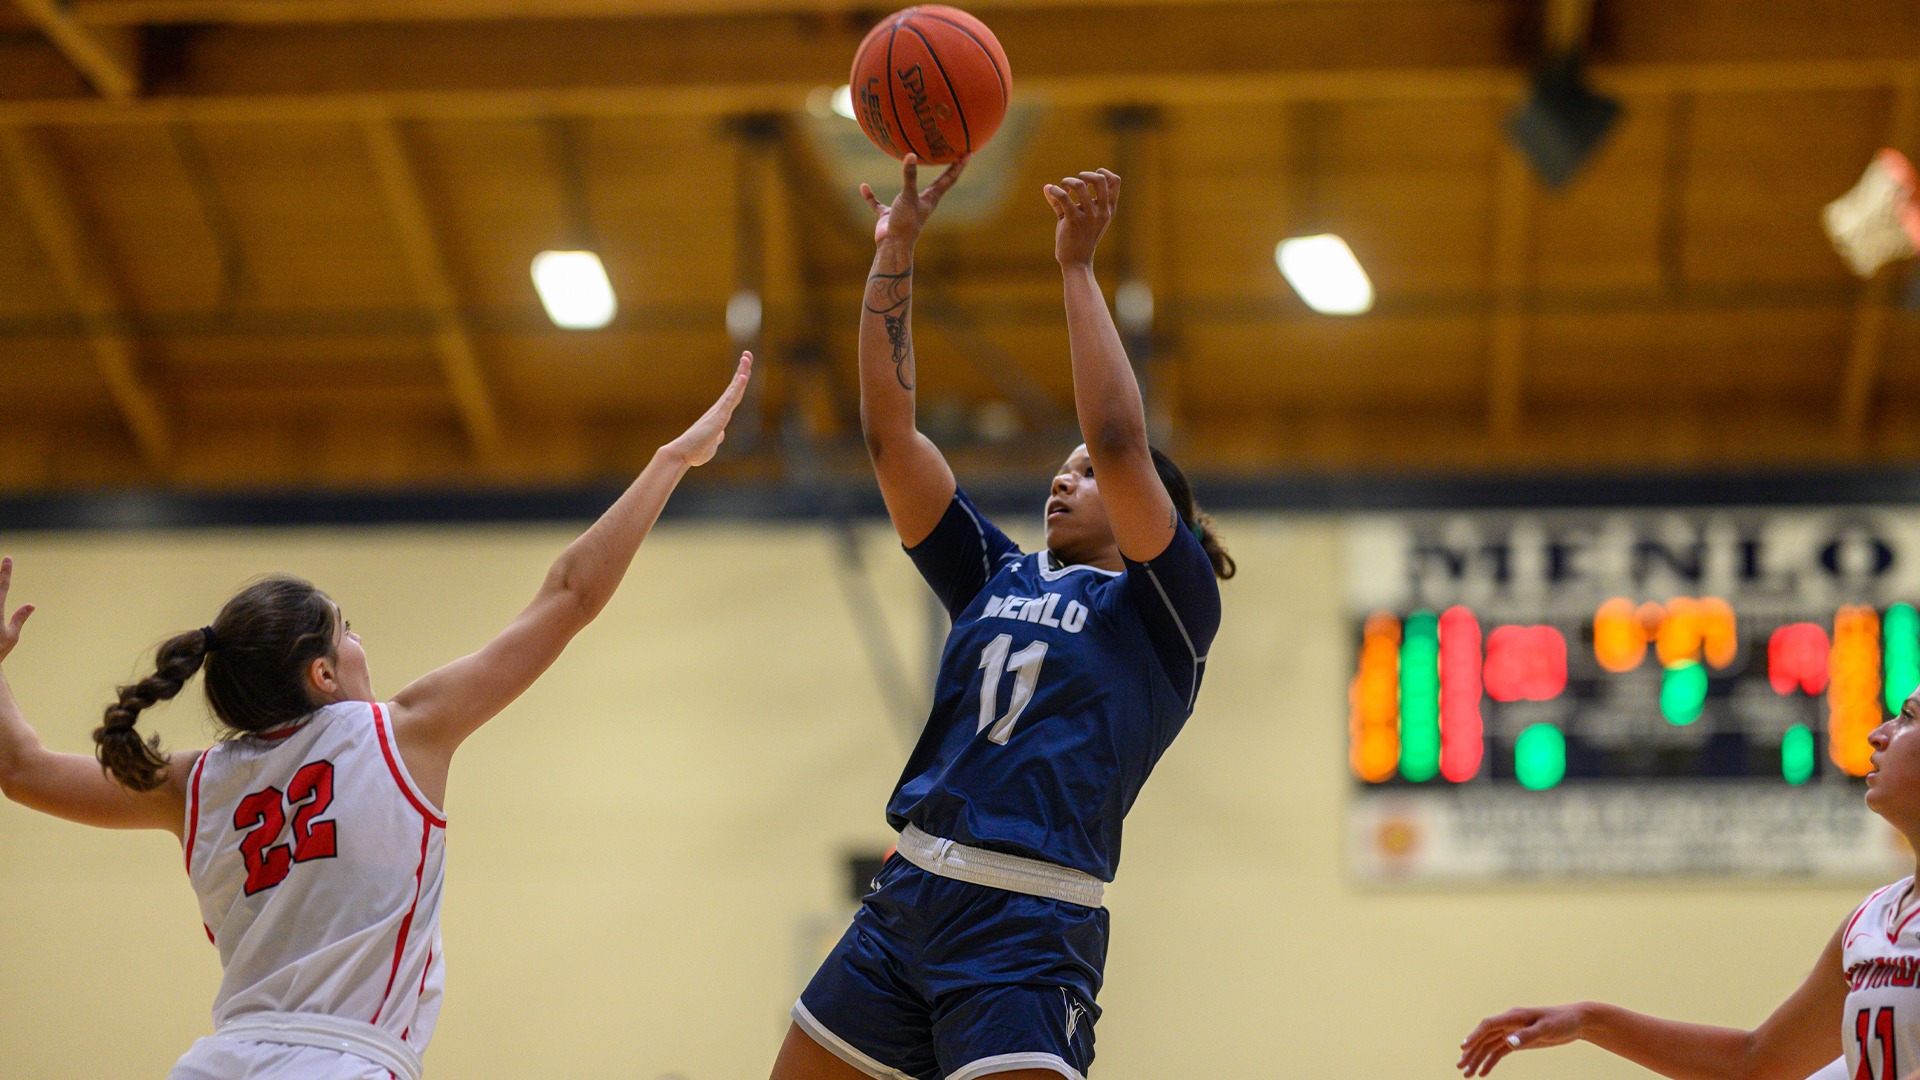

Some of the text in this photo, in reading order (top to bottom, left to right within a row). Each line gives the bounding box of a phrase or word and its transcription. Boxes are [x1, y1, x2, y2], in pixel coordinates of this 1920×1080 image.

[1410, 527, 1896, 590] MENLO
[979, 592, 1089, 633] MENLO
[976, 633, 1048, 746] 11
[233, 759, 338, 897] 22
[1855, 1006, 1898, 1080] 11
